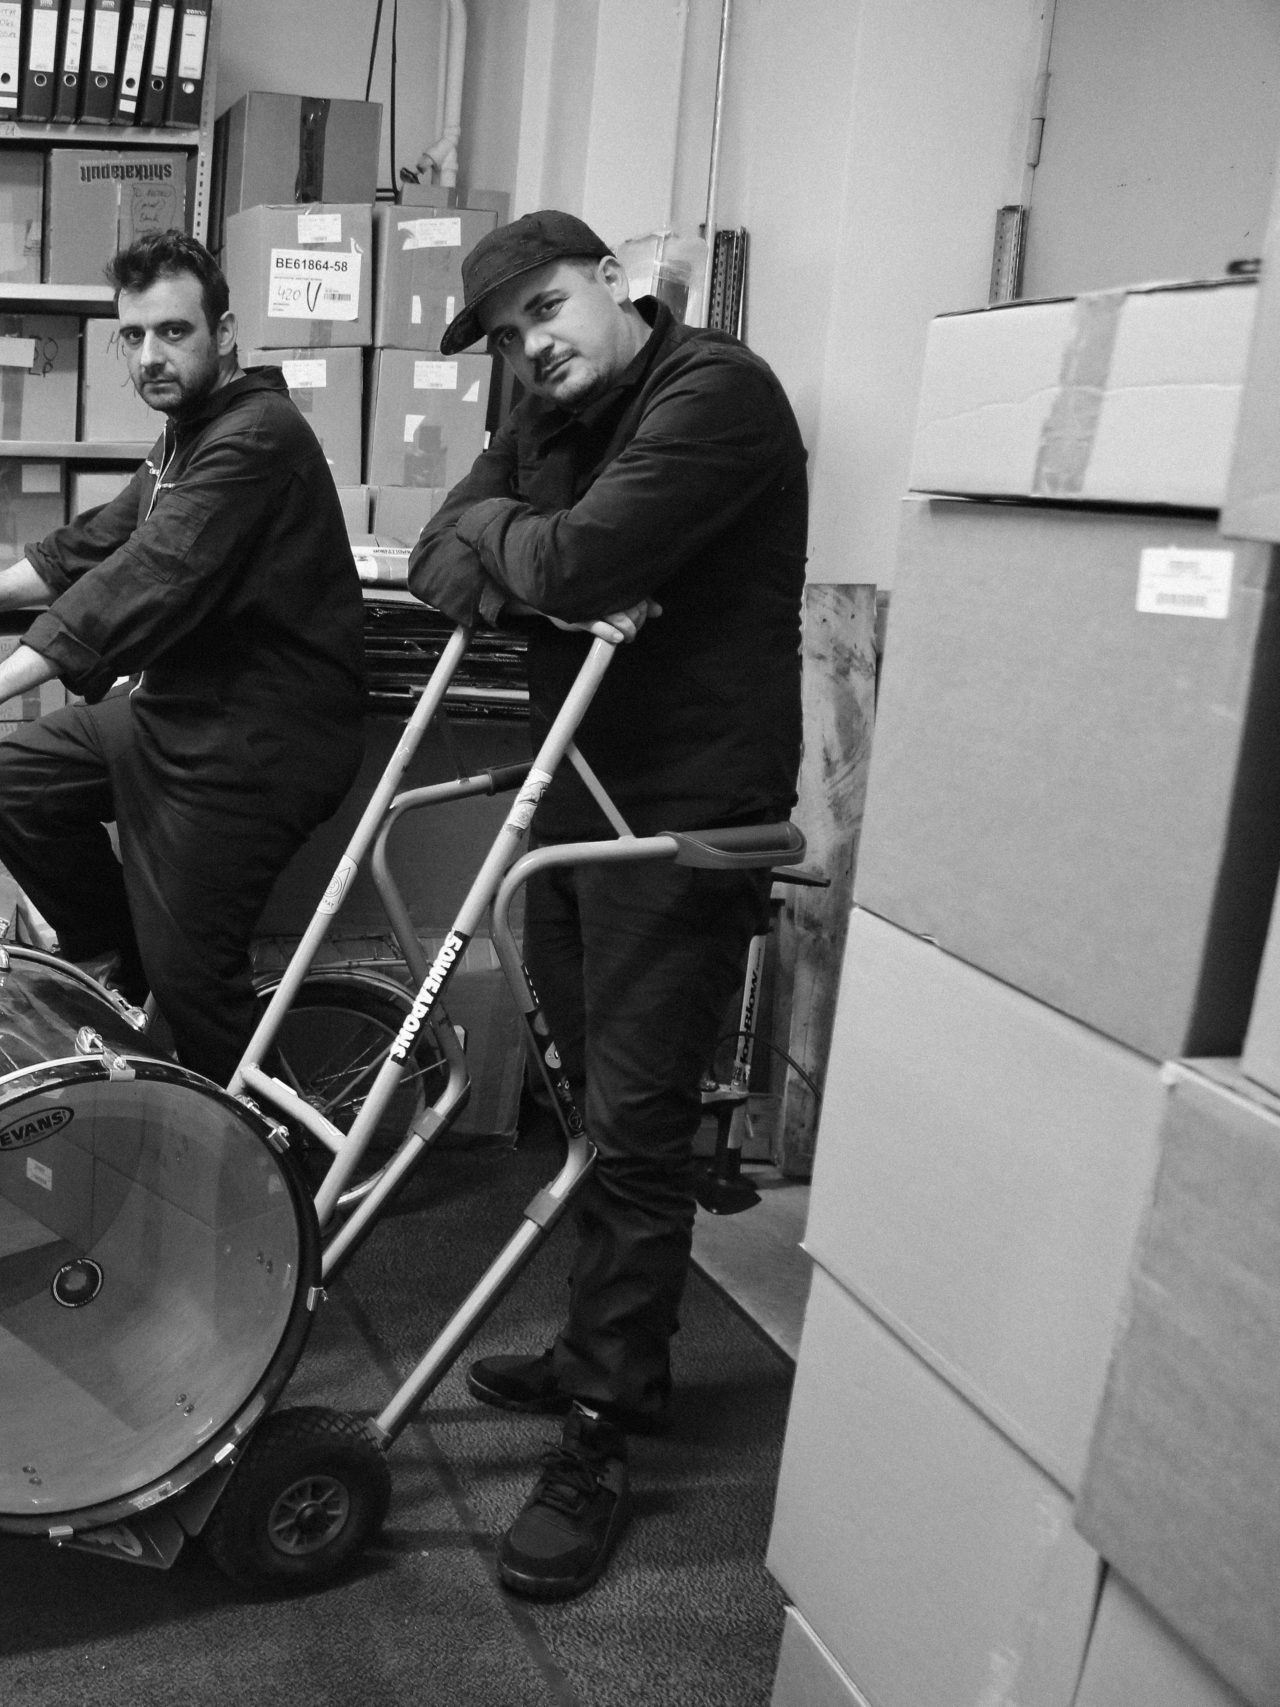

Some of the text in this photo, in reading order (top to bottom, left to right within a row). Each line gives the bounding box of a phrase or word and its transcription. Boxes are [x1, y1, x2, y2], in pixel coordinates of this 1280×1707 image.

[80, 164, 172, 182] shitkatapult
[275, 257, 349, 272] BE61864-58
[277, 285, 302, 301] 420
